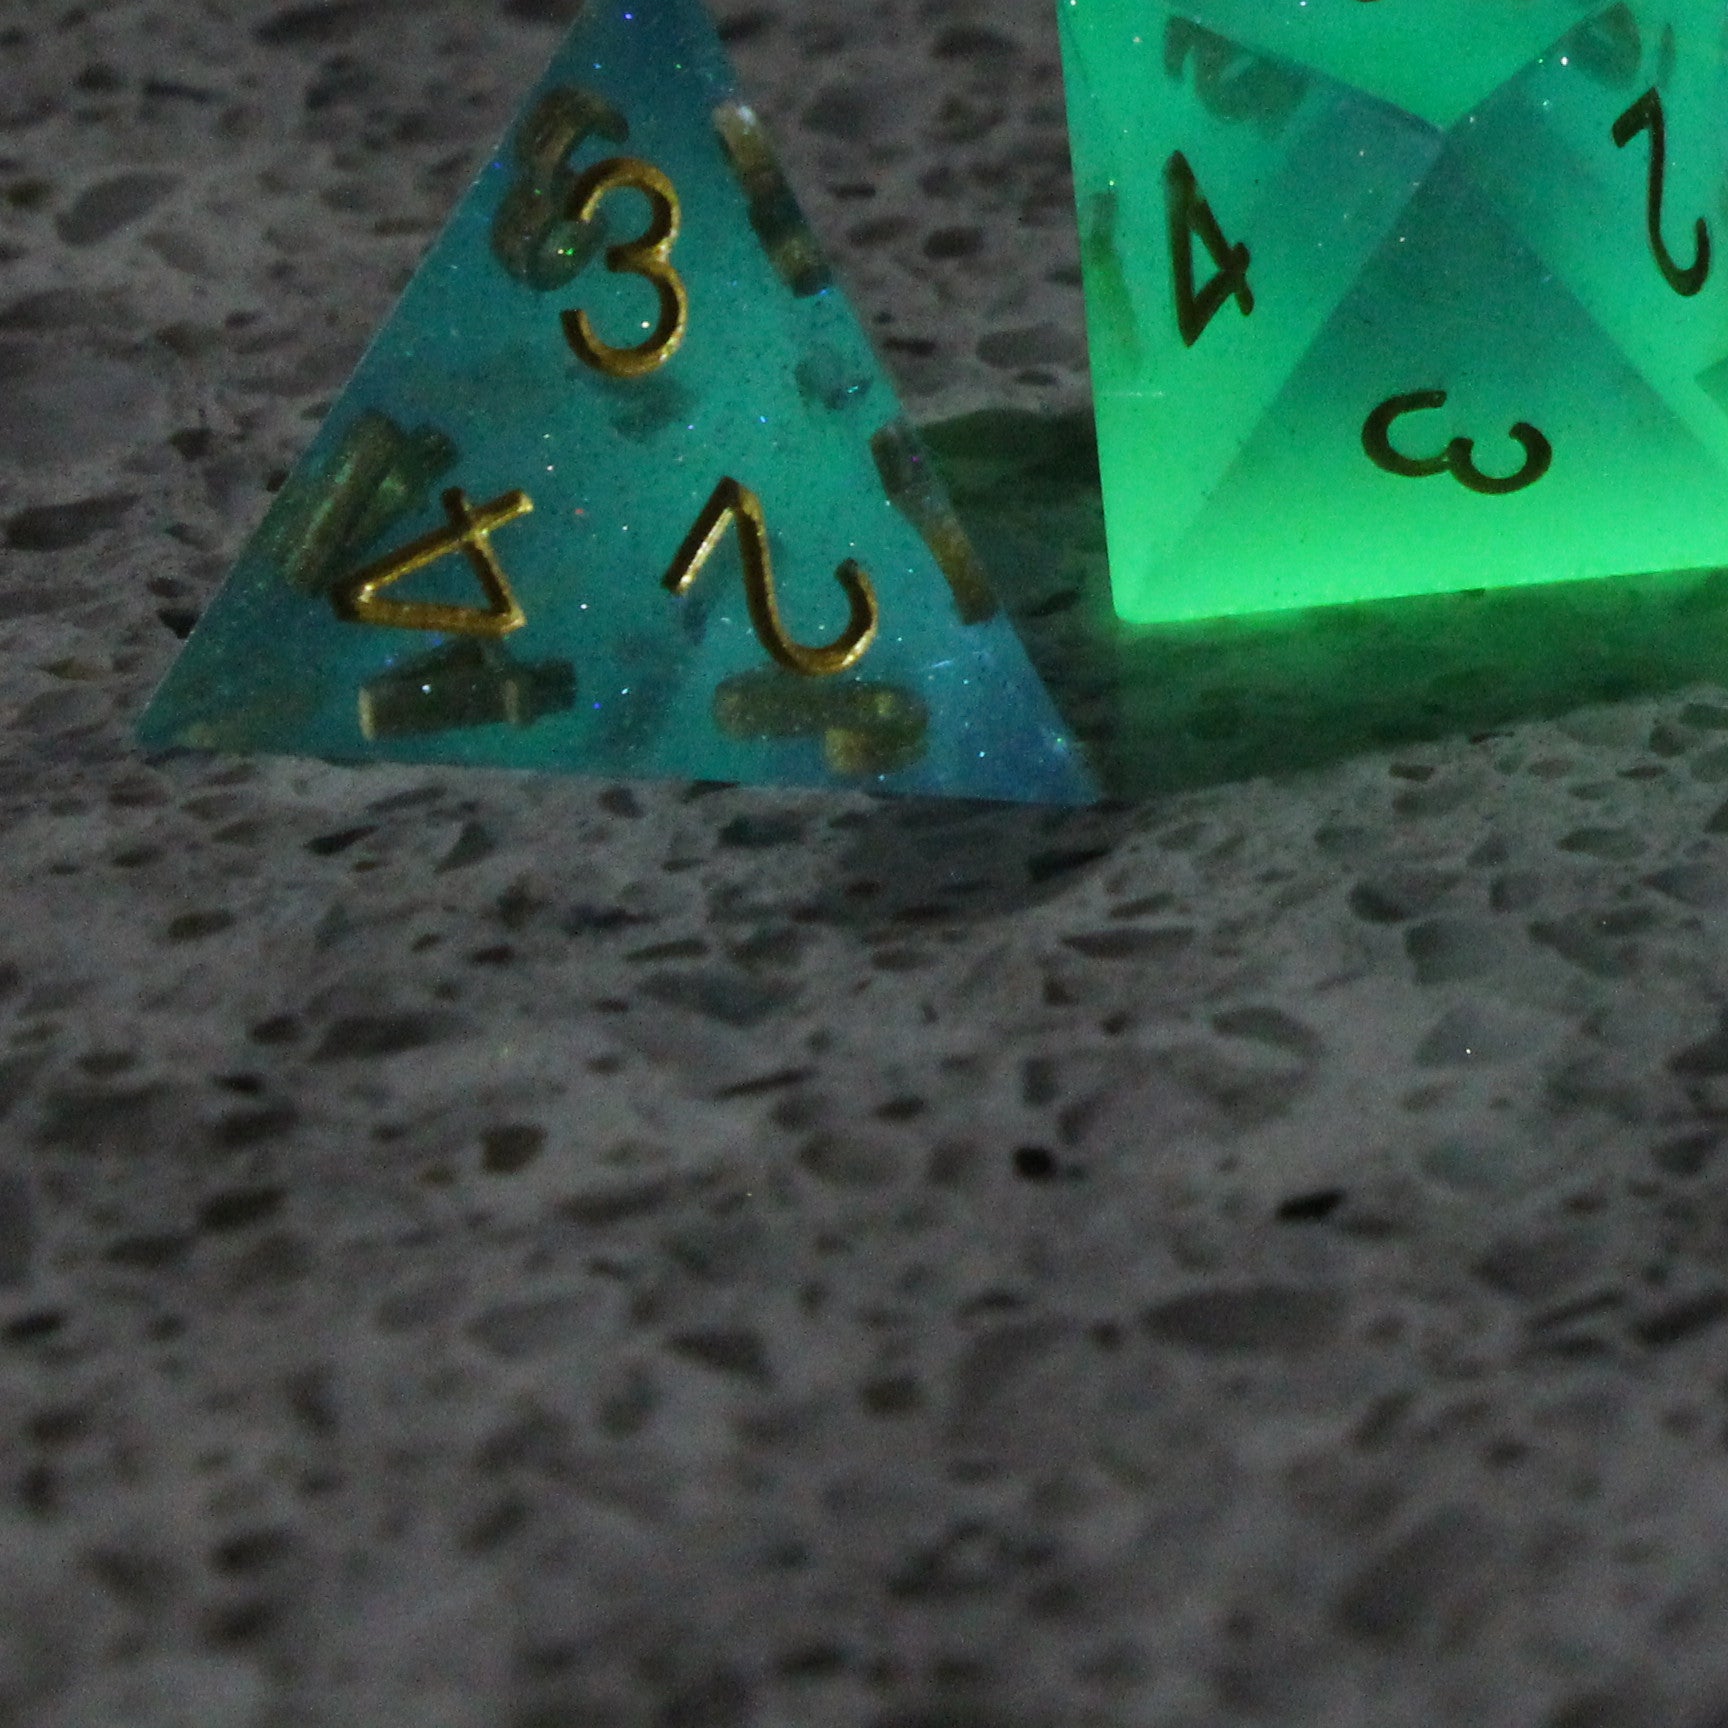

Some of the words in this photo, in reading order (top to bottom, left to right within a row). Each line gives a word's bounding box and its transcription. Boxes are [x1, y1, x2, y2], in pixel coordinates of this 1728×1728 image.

[558, 156, 688, 379] 3
[1163, 148, 1256, 348] 4
[1611, 87, 1710, 298] 2
[1361, 389, 1553, 495] 3
[332, 486, 533, 637] 4
[661, 475, 878, 676] 2
